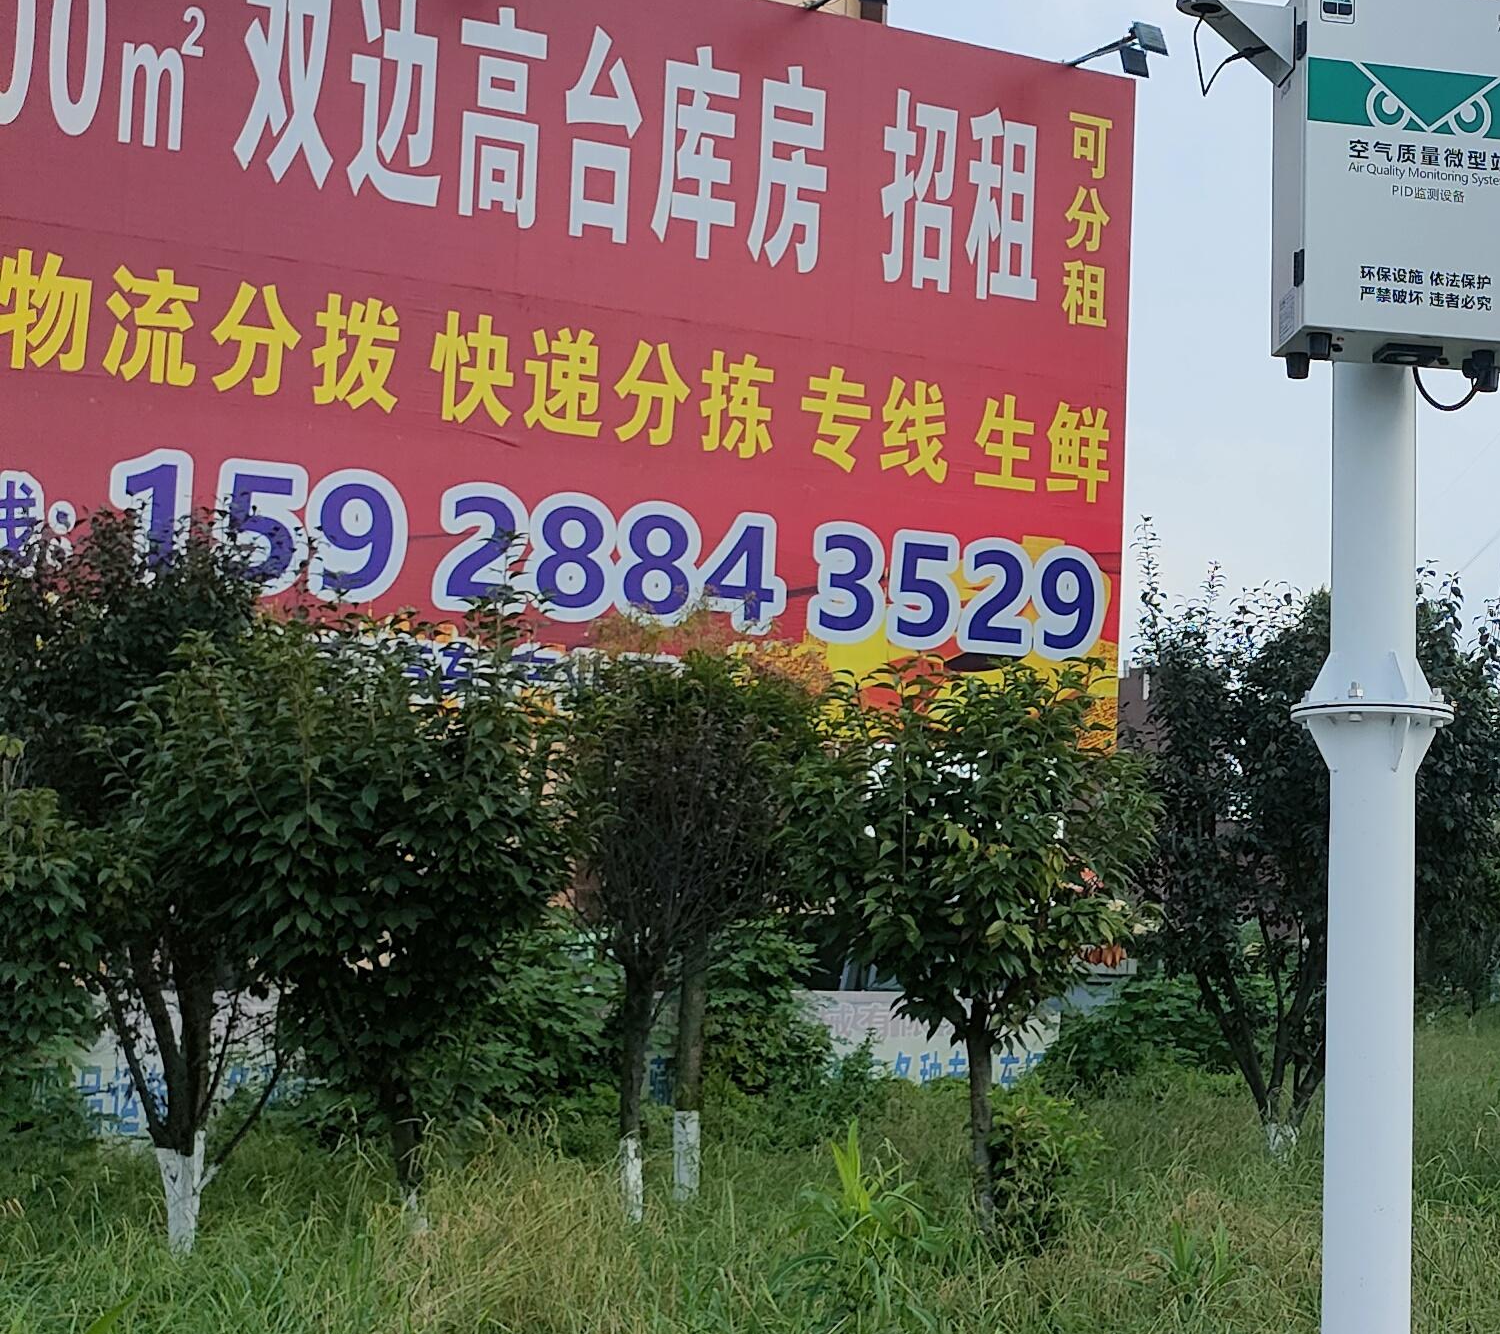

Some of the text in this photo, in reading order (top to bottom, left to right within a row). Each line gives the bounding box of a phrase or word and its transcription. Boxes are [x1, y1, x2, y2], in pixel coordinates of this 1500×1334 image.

[882, 89, 1037, 301] 招租
[1062, 111, 1112, 328] 可分租
[1348, 161, 1365, 173] Air
[1366, 163, 1406, 179] Quality
[1408, 167, 1469, 185] Monitoring
[1392, 185, 1465, 204] PID监测设备
[1359, 265, 1491, 290] 环保设施 依法保护
[1359, 285, 1492, 311] 严禁破坏 违者必究
[0, 247, 1111, 502] 物流分拨 快递分拣 专线 生鲜
[114, 454, 403, 597] 159
[435, 485, 782, 631] 2884
[810, 524, 1103, 658] 3529
